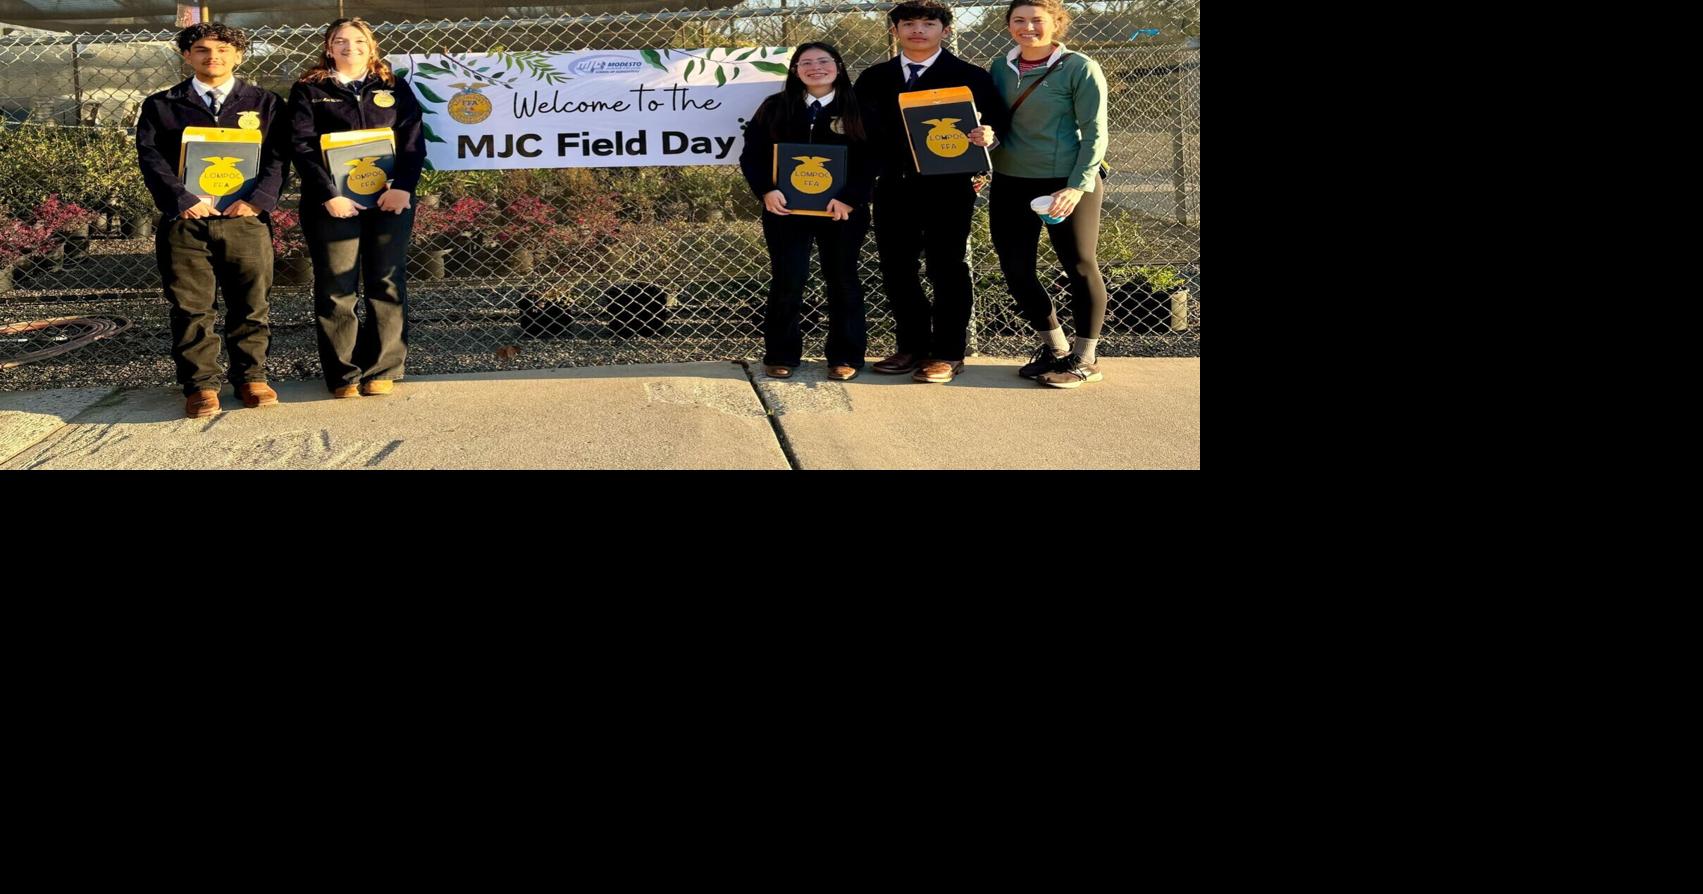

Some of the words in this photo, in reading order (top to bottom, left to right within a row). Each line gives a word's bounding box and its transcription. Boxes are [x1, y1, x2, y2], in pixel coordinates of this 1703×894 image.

[513, 90, 631, 119] Welcome
[630, 83, 664, 112] to
[663, 83, 722, 111] the
[457, 133, 543, 159] MJC
[557, 130, 647, 157] Field
[661, 131, 736, 159] Day
[929, 133, 965, 141] LOMPOC
[349, 170, 384, 181] LOMPOC
